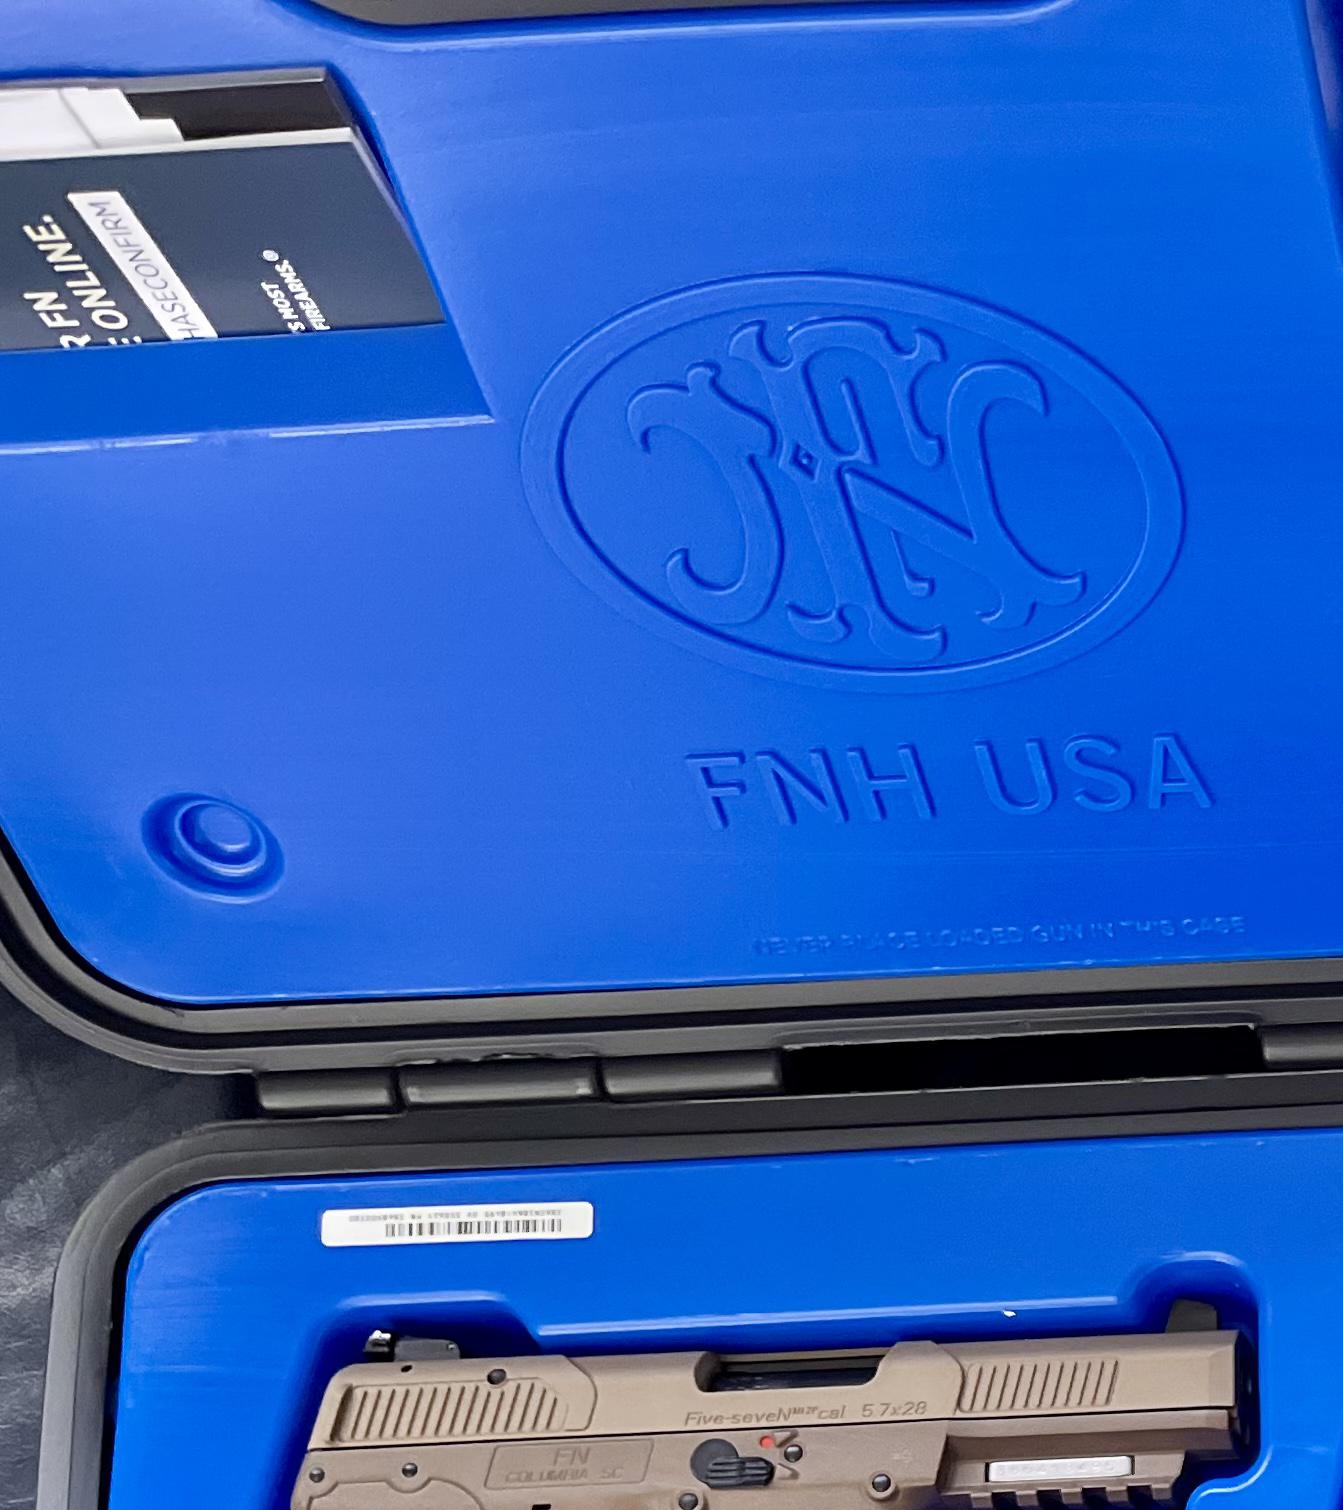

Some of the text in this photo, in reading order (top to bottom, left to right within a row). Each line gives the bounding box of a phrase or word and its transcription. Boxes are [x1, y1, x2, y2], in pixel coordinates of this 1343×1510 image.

[22, 214, 129, 330] ONLINE.
[23, 291, 80, 328] FN
[261, 281, 298, 319] MOST
[686, 733, 1216, 829] FNH USA
[1032, 922, 1084, 943] GUN
[552, 1447, 591, 1467] FN
